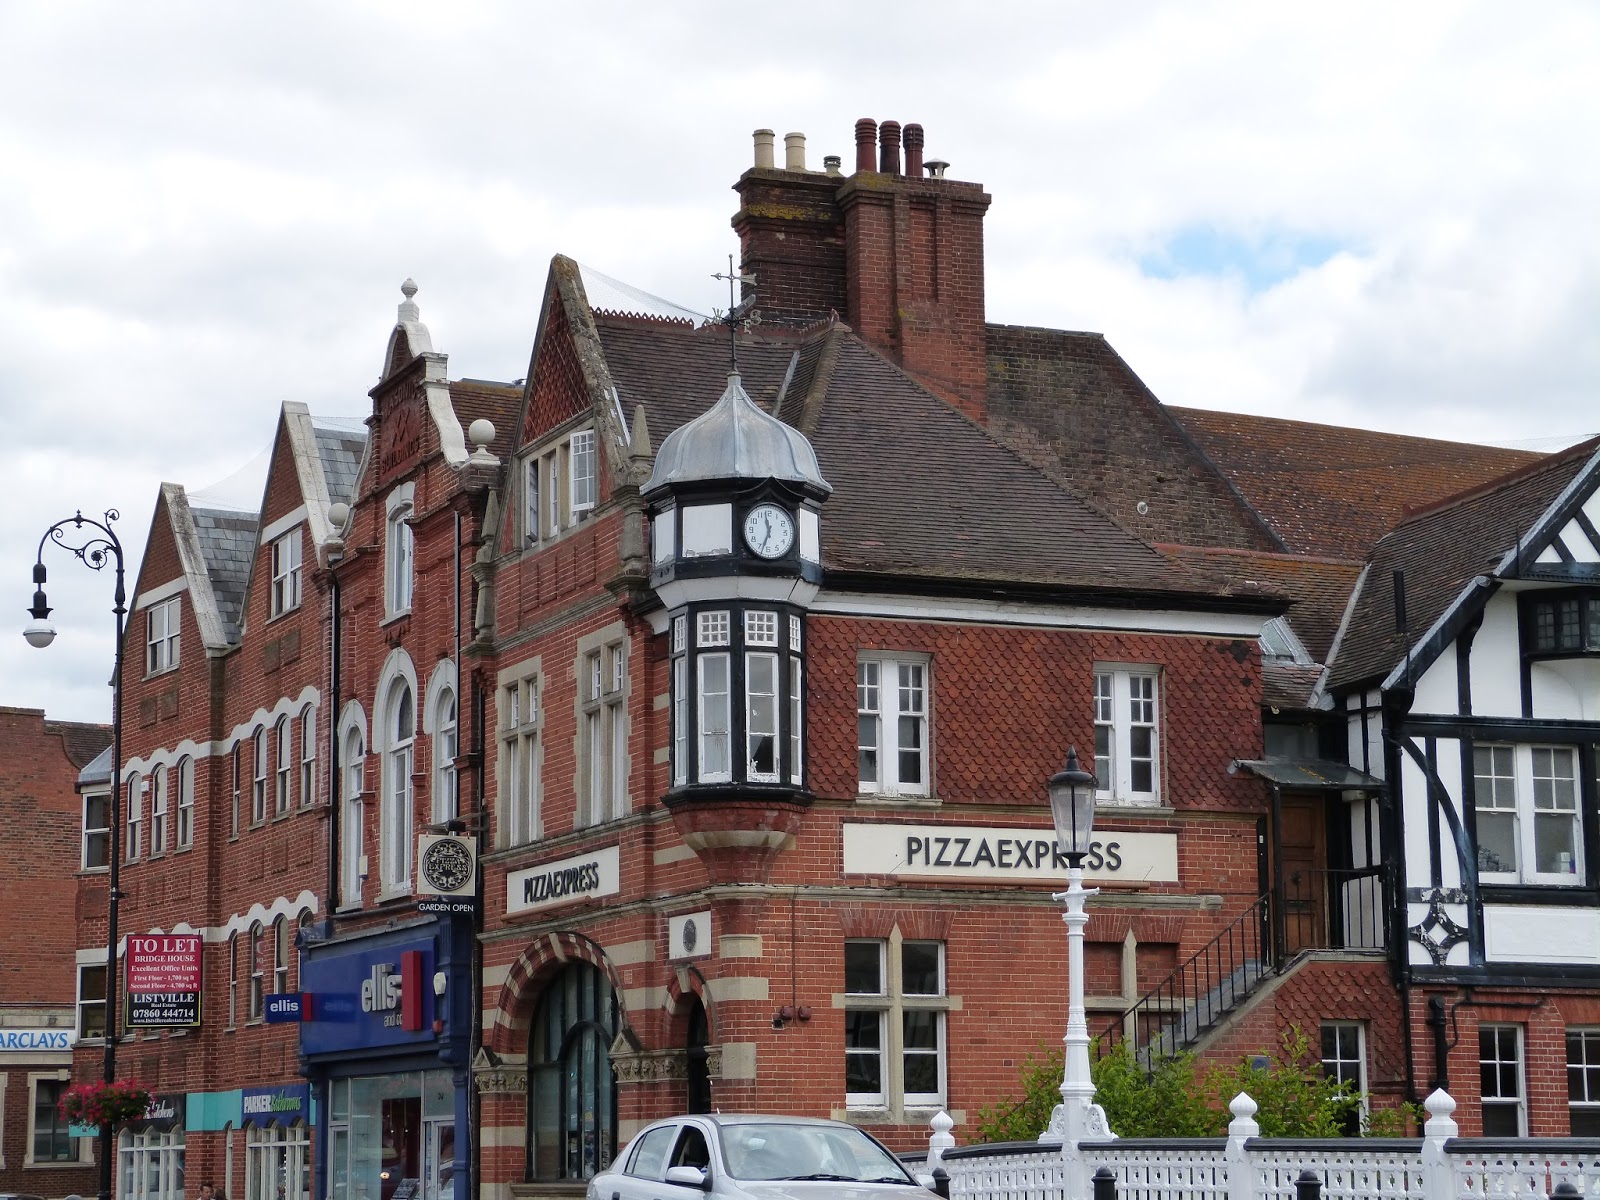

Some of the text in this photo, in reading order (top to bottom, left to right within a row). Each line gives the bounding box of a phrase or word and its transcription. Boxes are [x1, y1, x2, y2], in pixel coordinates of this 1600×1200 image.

[382, 436, 420, 474] BUILDINGS
[907, 836, 1122, 870] PIZZAEXPRSS
[523, 861, 599, 904] PIZZAEXPRESS
[418, 903, 474, 912] GARDEN OPEN
[132, 938, 198, 952] TO LET
[362, 963, 400, 1012] ellis
[134, 993, 194, 1003] LISTVILLE
[270, 1000, 298, 1012] ellis
[133, 1008, 194, 1018] 07860 444714
[244, 1094, 271, 1114] PARKER
